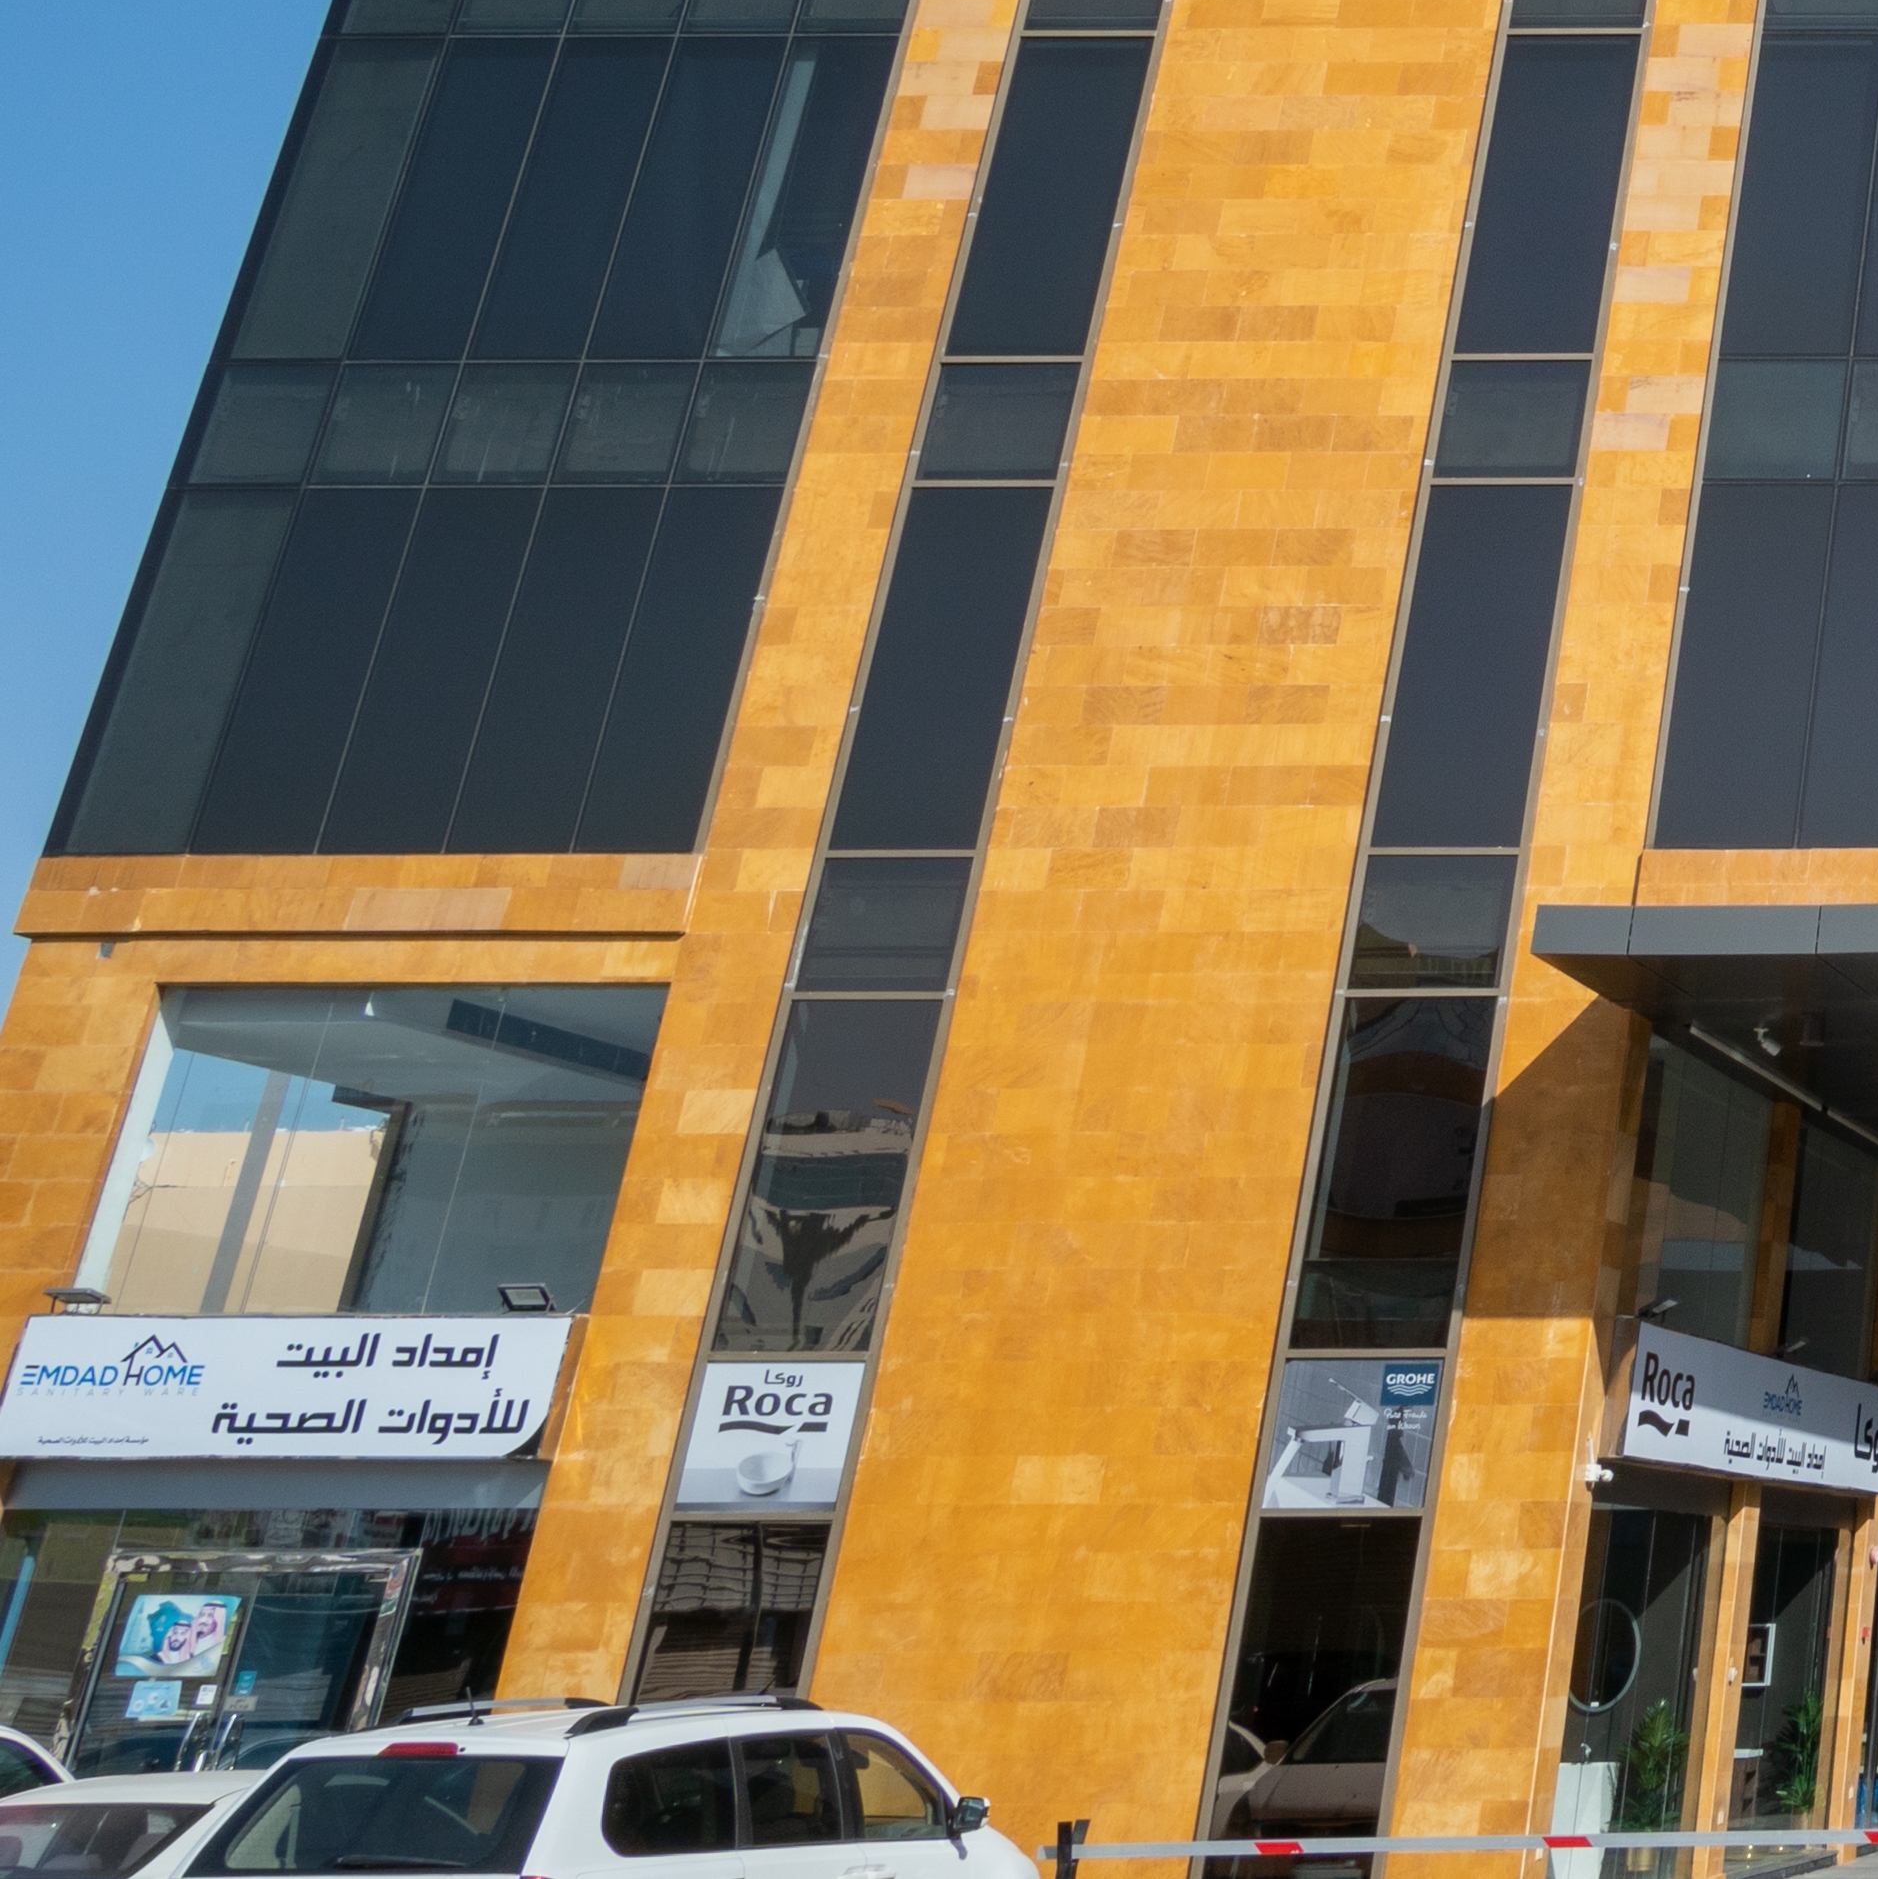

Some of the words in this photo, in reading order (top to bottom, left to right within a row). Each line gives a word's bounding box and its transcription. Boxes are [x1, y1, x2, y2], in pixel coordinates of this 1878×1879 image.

[20, 1365, 118, 1386] EMDAD
[122, 1362, 206, 1386] HOME
[276, 1332, 382, 1379] البيت
[392, 1333, 500, 1380] إمداد
[16, 1387, 126, 1397] SANITARY
[143, 1387, 200, 1397] WARE
[764, 1369, 804, 1388] روكا
[1386, 1373, 1436, 1385] GROHE
[1640, 1351, 1696, 1411] Roca
[378, 1388, 531, 1445] للأدوات
[722, 1385, 834, 1416] Roca
[211, 1399, 368, 1445] الصحية
